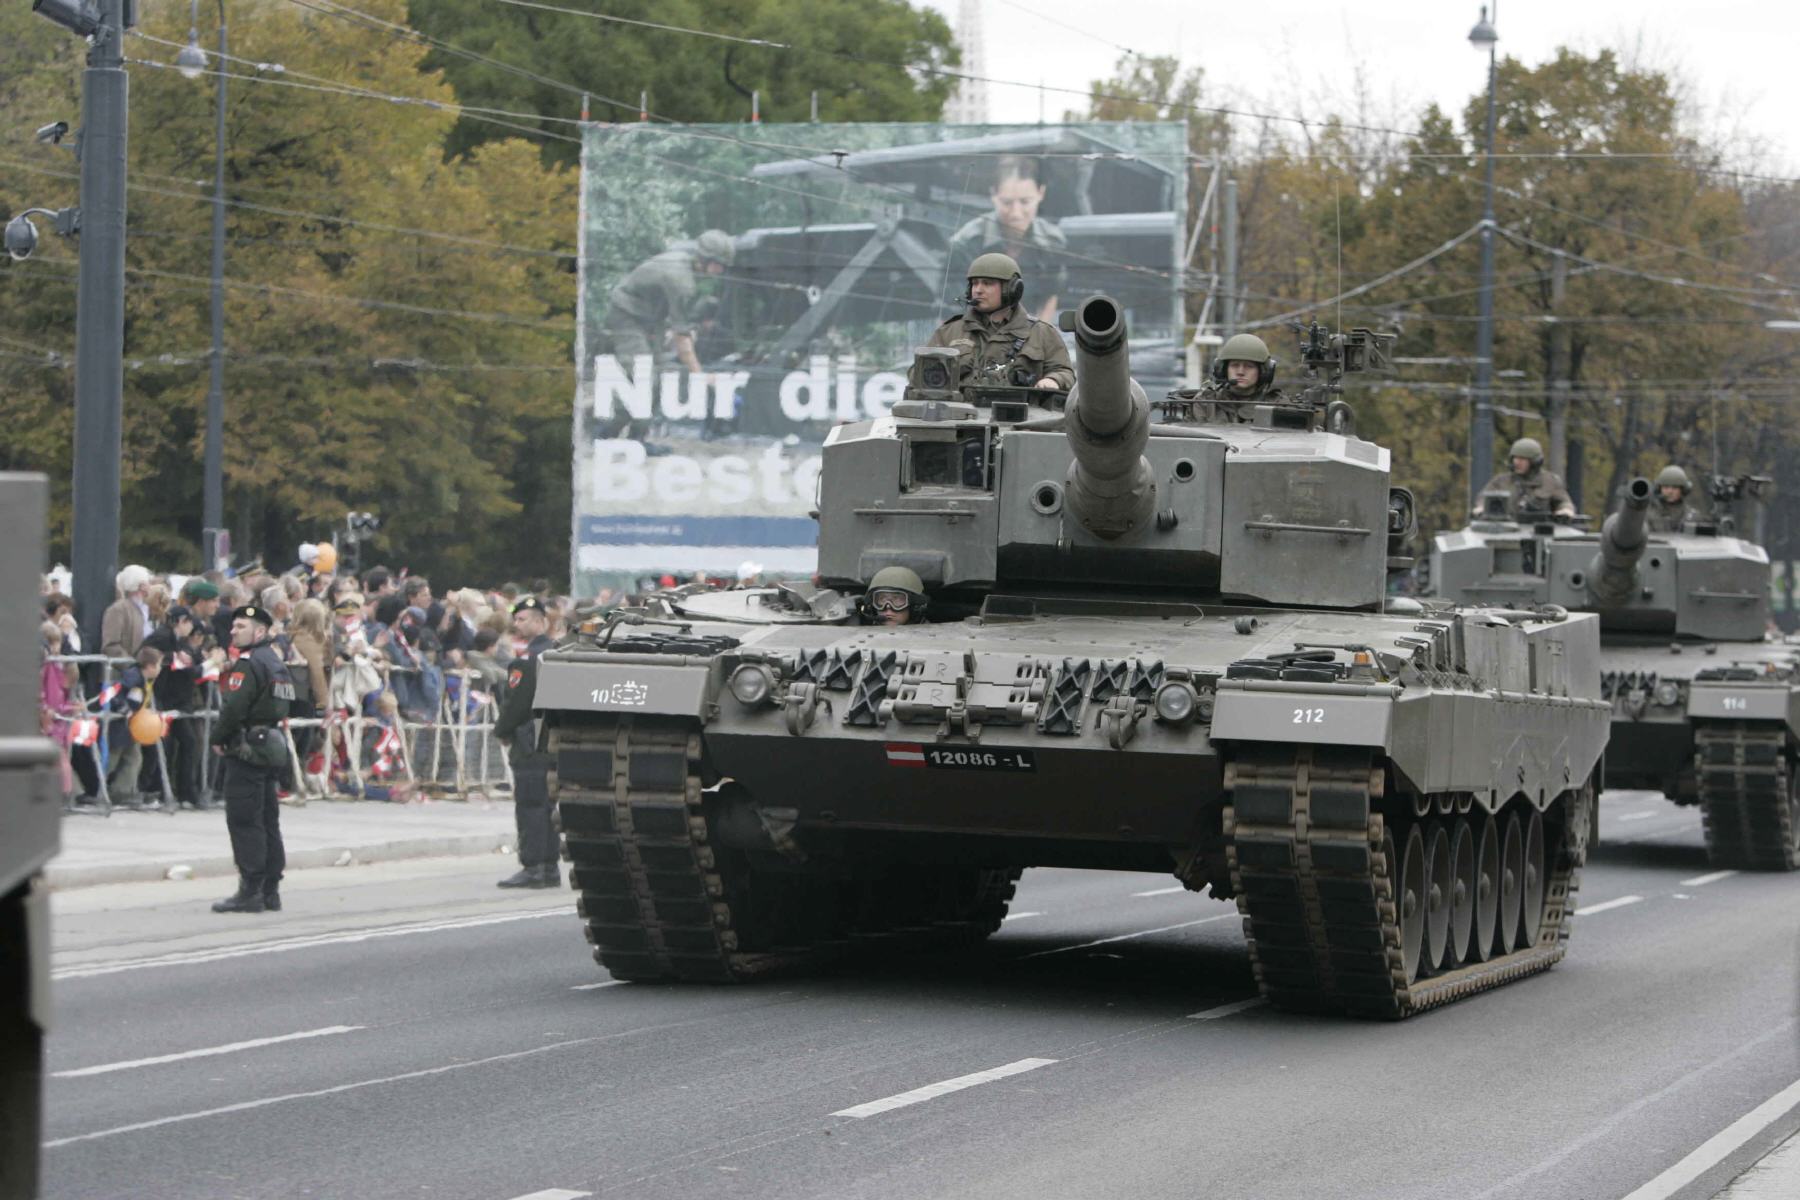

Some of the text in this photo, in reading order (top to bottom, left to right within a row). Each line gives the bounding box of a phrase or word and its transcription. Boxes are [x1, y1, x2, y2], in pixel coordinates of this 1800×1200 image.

[593, 354, 908, 421] Nur die
[590, 689, 609, 704] 10
[1293, 708, 1325, 724] 212
[930, 751, 997, 767] 12086
